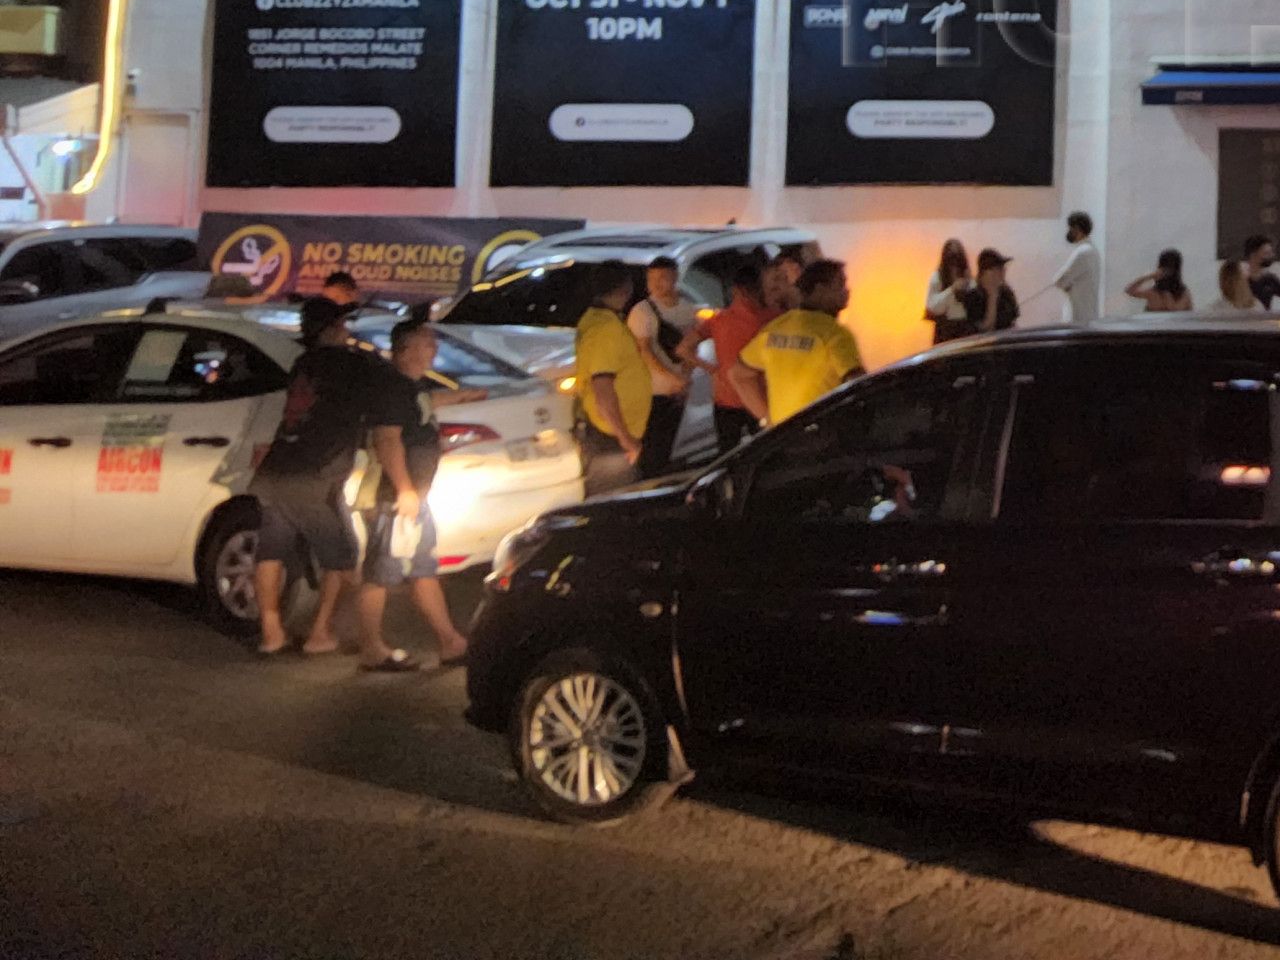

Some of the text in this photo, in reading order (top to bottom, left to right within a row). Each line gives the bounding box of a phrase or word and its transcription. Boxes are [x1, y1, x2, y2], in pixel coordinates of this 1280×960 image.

[586, 18, 663, 40] 10PM
[303, 242, 465, 265] NO SMOKING
[343, 264, 391, 280] OUD
[395, 265, 462, 282] NOISES
